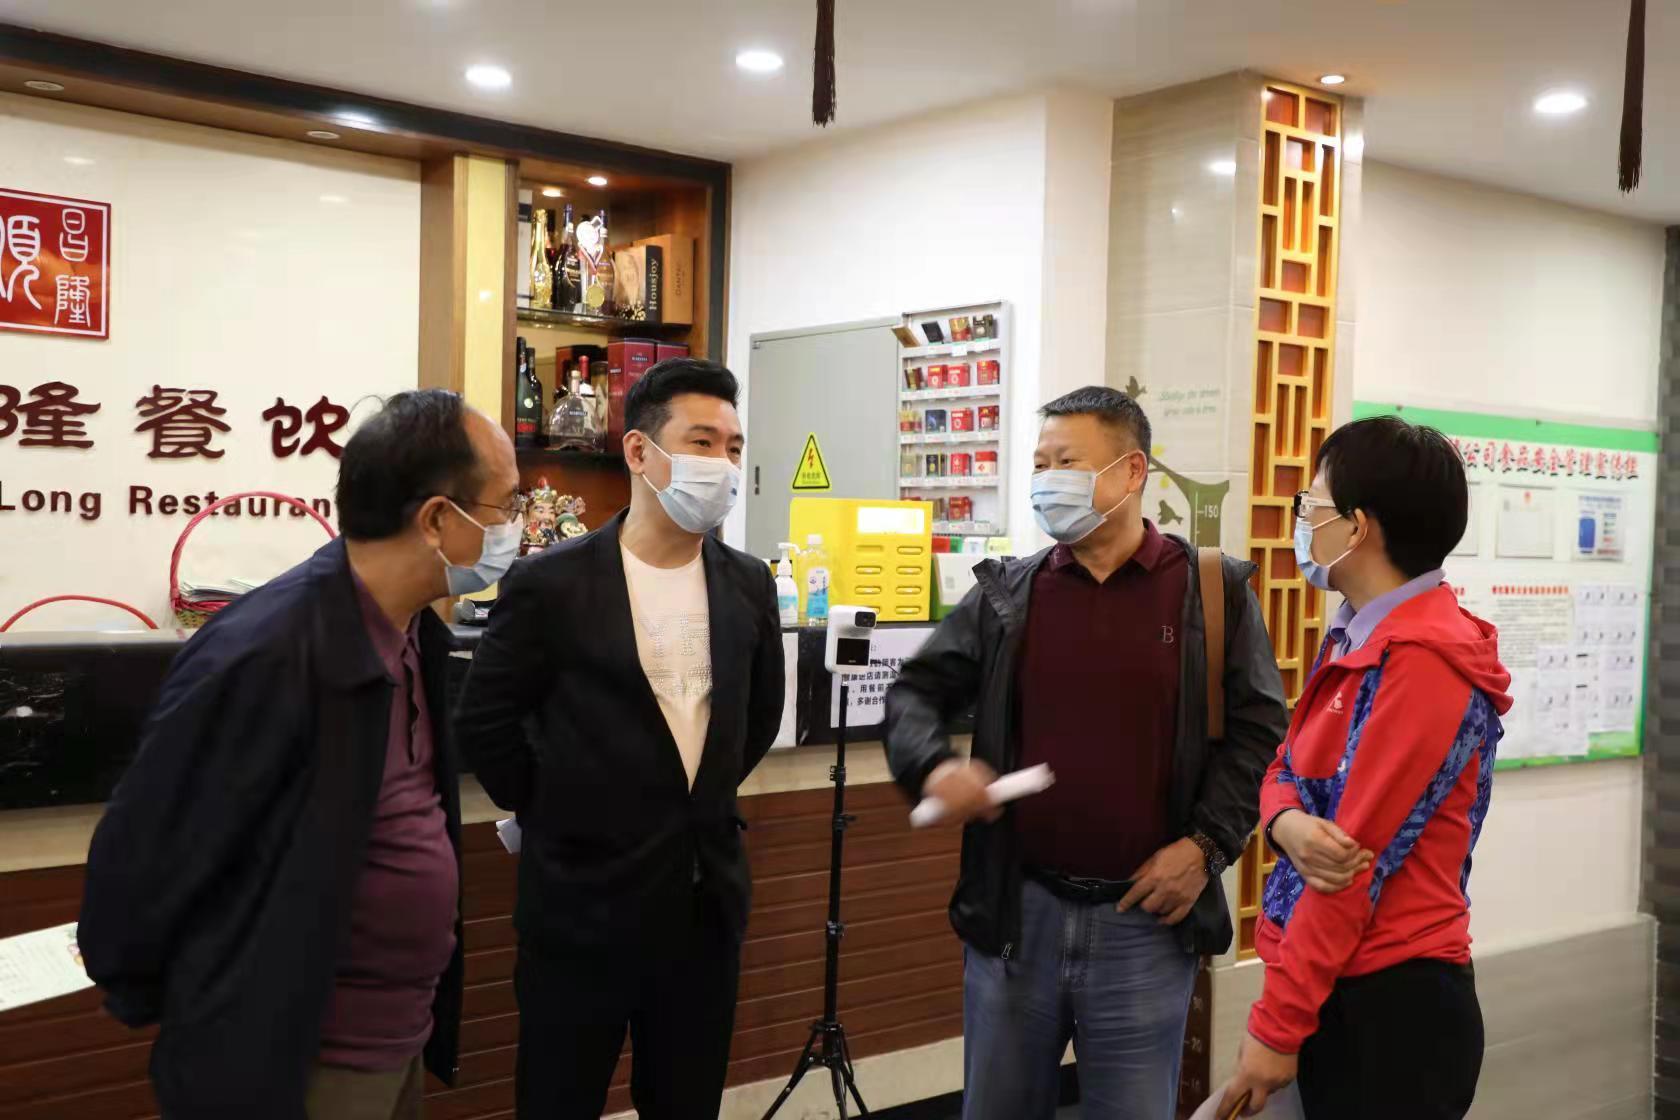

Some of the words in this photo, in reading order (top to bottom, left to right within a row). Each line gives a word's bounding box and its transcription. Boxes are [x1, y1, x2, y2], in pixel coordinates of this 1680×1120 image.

[648, 258, 659, 311] Housjoy
[0, 481, 102, 521] Long
[129, 485, 332, 518] Restauran
[1161, 625, 1174, 643] B
